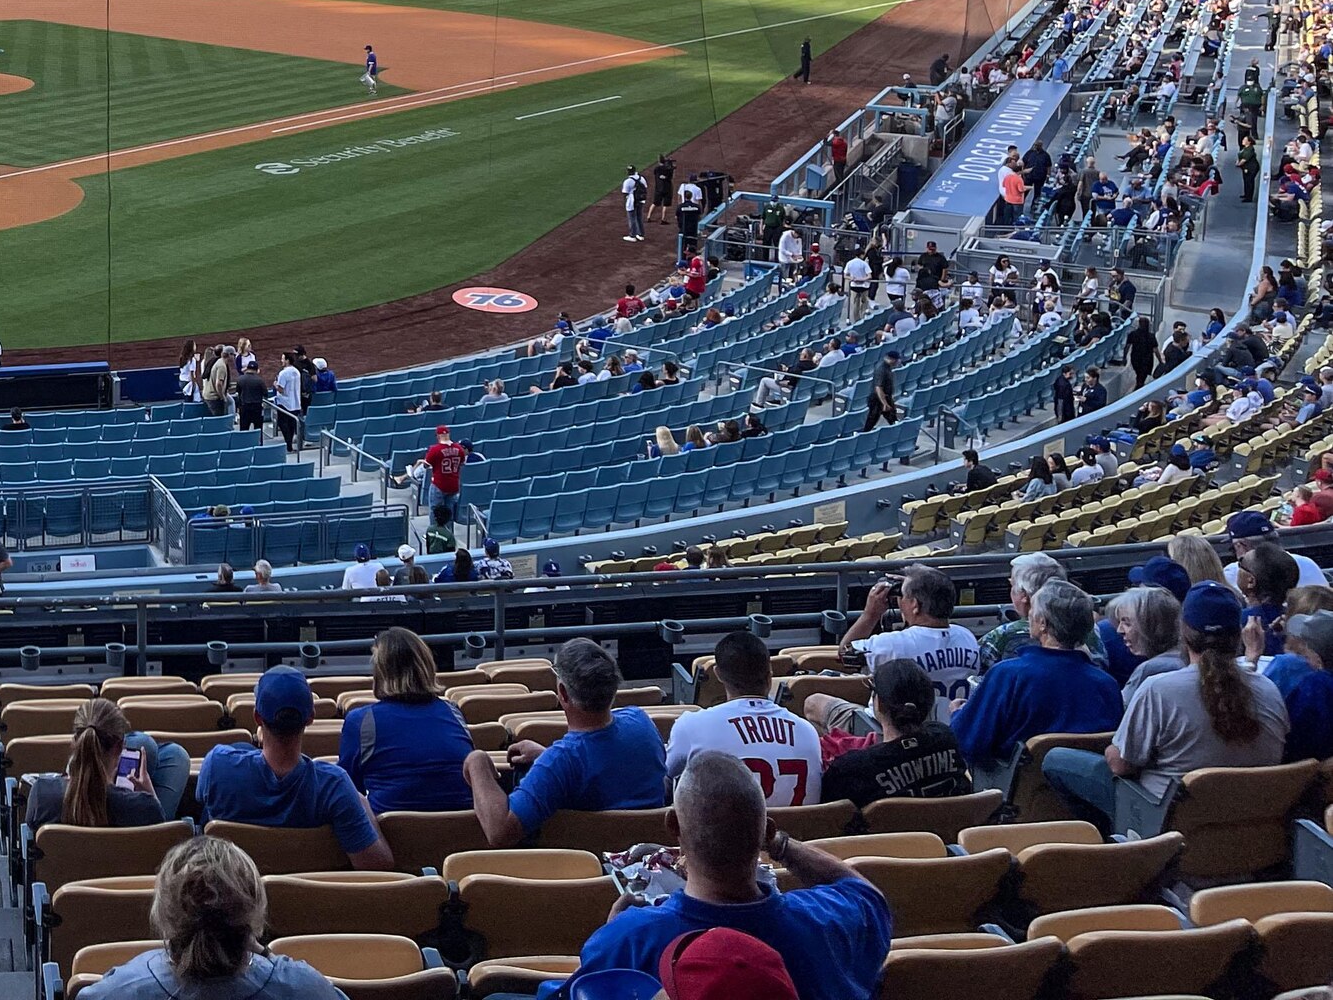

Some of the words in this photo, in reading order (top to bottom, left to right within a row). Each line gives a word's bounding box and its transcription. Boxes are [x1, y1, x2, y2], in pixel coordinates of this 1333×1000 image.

[290, 143, 391, 168] Security
[377, 127, 462, 148] Benefit
[952, 136, 1017, 182] DODGER
[987, 98, 1046, 137] STADIUM
[465, 292, 527, 308] 76
[442, 456, 461, 473] 27
[728, 715, 796, 747] TROUT
[875, 749, 958, 795] SHOWTIME
